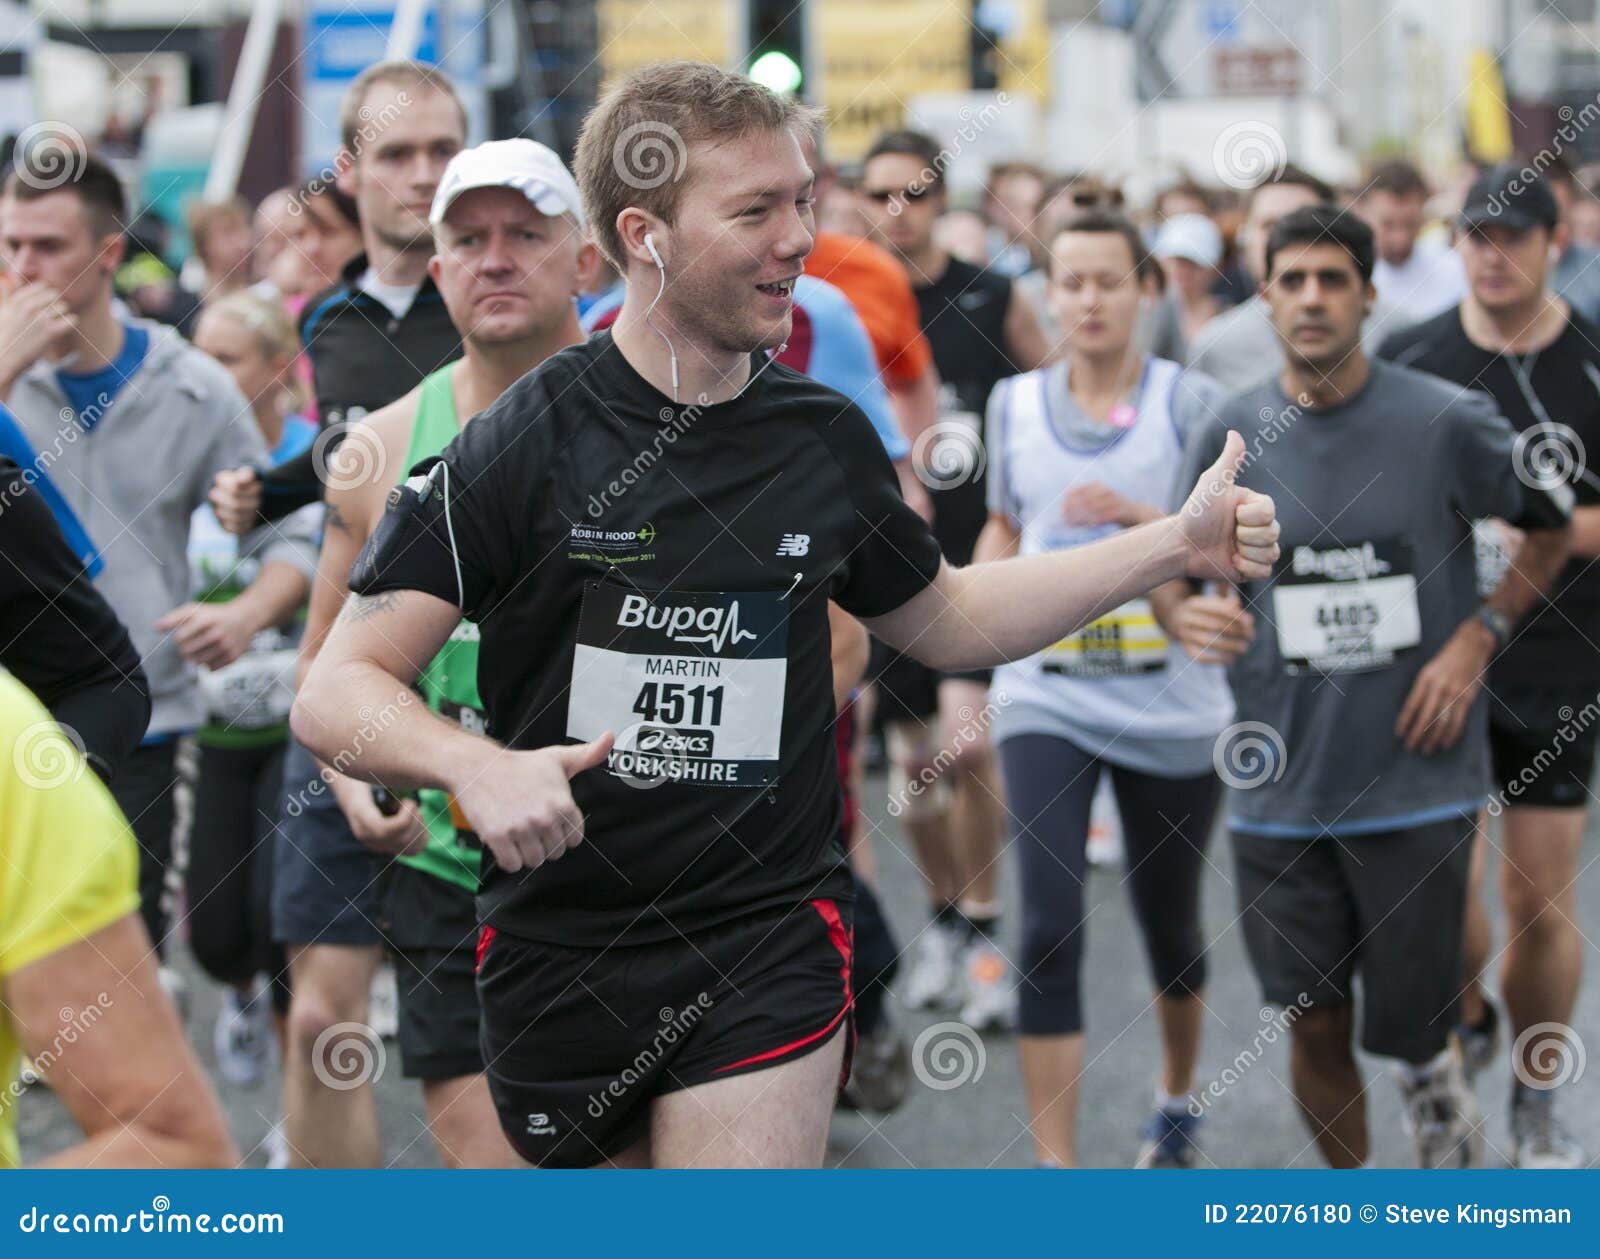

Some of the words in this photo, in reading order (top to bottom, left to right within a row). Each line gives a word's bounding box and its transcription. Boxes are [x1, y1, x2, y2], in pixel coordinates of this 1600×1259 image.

[570, 528, 603, 540] ROBIN
[604, 530, 637, 541] HOOD
[616, 594, 726, 638] Bupa
[645, 658, 721, 678] MARTIN
[632, 681, 725, 727] 4511
[607, 752, 740, 782] YORKSHIRE
